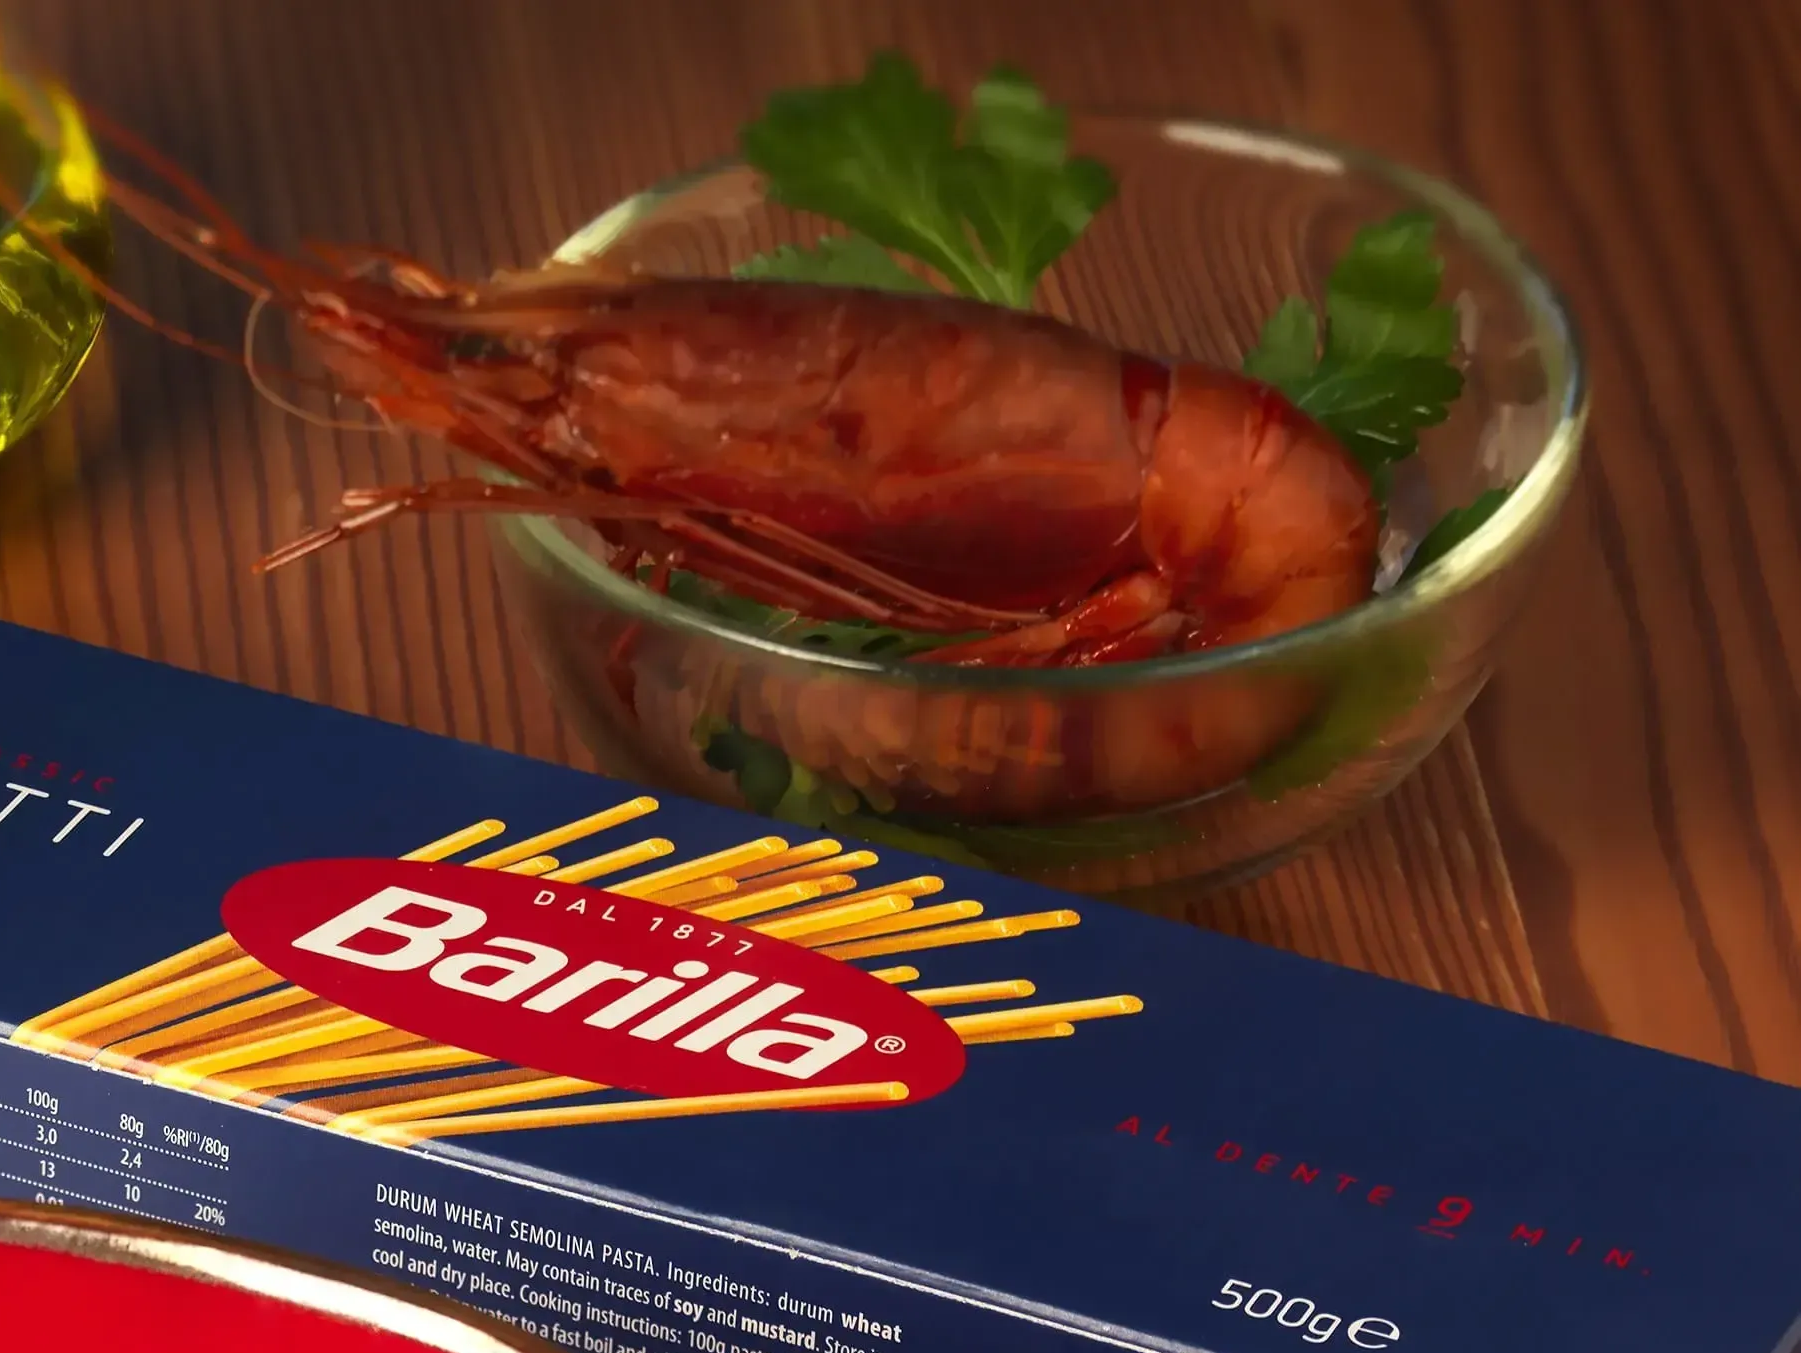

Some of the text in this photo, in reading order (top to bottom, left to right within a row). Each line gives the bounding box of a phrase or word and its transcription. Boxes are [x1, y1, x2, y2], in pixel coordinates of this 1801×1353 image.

[533, 890, 754, 958] DAL 1877
[25, 1087, 60, 1115] 100g
[119, 1114, 145, 1139] 80g
[35, 1124, 58, 1147] 3,0
[119, 1148, 143, 1170] 2,4
[39, 1160, 56, 1180] 13
[123, 1183, 141, 1204] 10
[194, 1202, 226, 1227] 20%
[1115, 1115, 1653, 1276] AL DENTE 9 MIN.
[372, 1248, 403, 1269] cool
[408, 1256, 437, 1278] and
[441, 1263, 466, 1290] dry
[470, 1272, 515, 1300] place.
[519, 1284, 581, 1322] Cooking
[586, 1301, 681, 1344] instructions:
[374, 1217, 448, 1253] semolina,
[452, 1239, 501, 1266] water.
[506, 1249, 539, 1278] May
[543, 1263, 600, 1292] contain
[604, 1277, 650, 1305] traces
[654, 1291, 672, 1310] of
[674, 1298, 704, 1323] soy
[707, 1305, 737, 1329] and
[741, 1315, 820, 1352] mustard.
[376, 1183, 902, 1343] DURUM WHEAT SEMOLINA PASTA. Ingredients: durum wheat
[521, 1316, 537, 1334] to
[539, 1323, 549, 1339] a
[552, 1323, 581, 1349] fast
